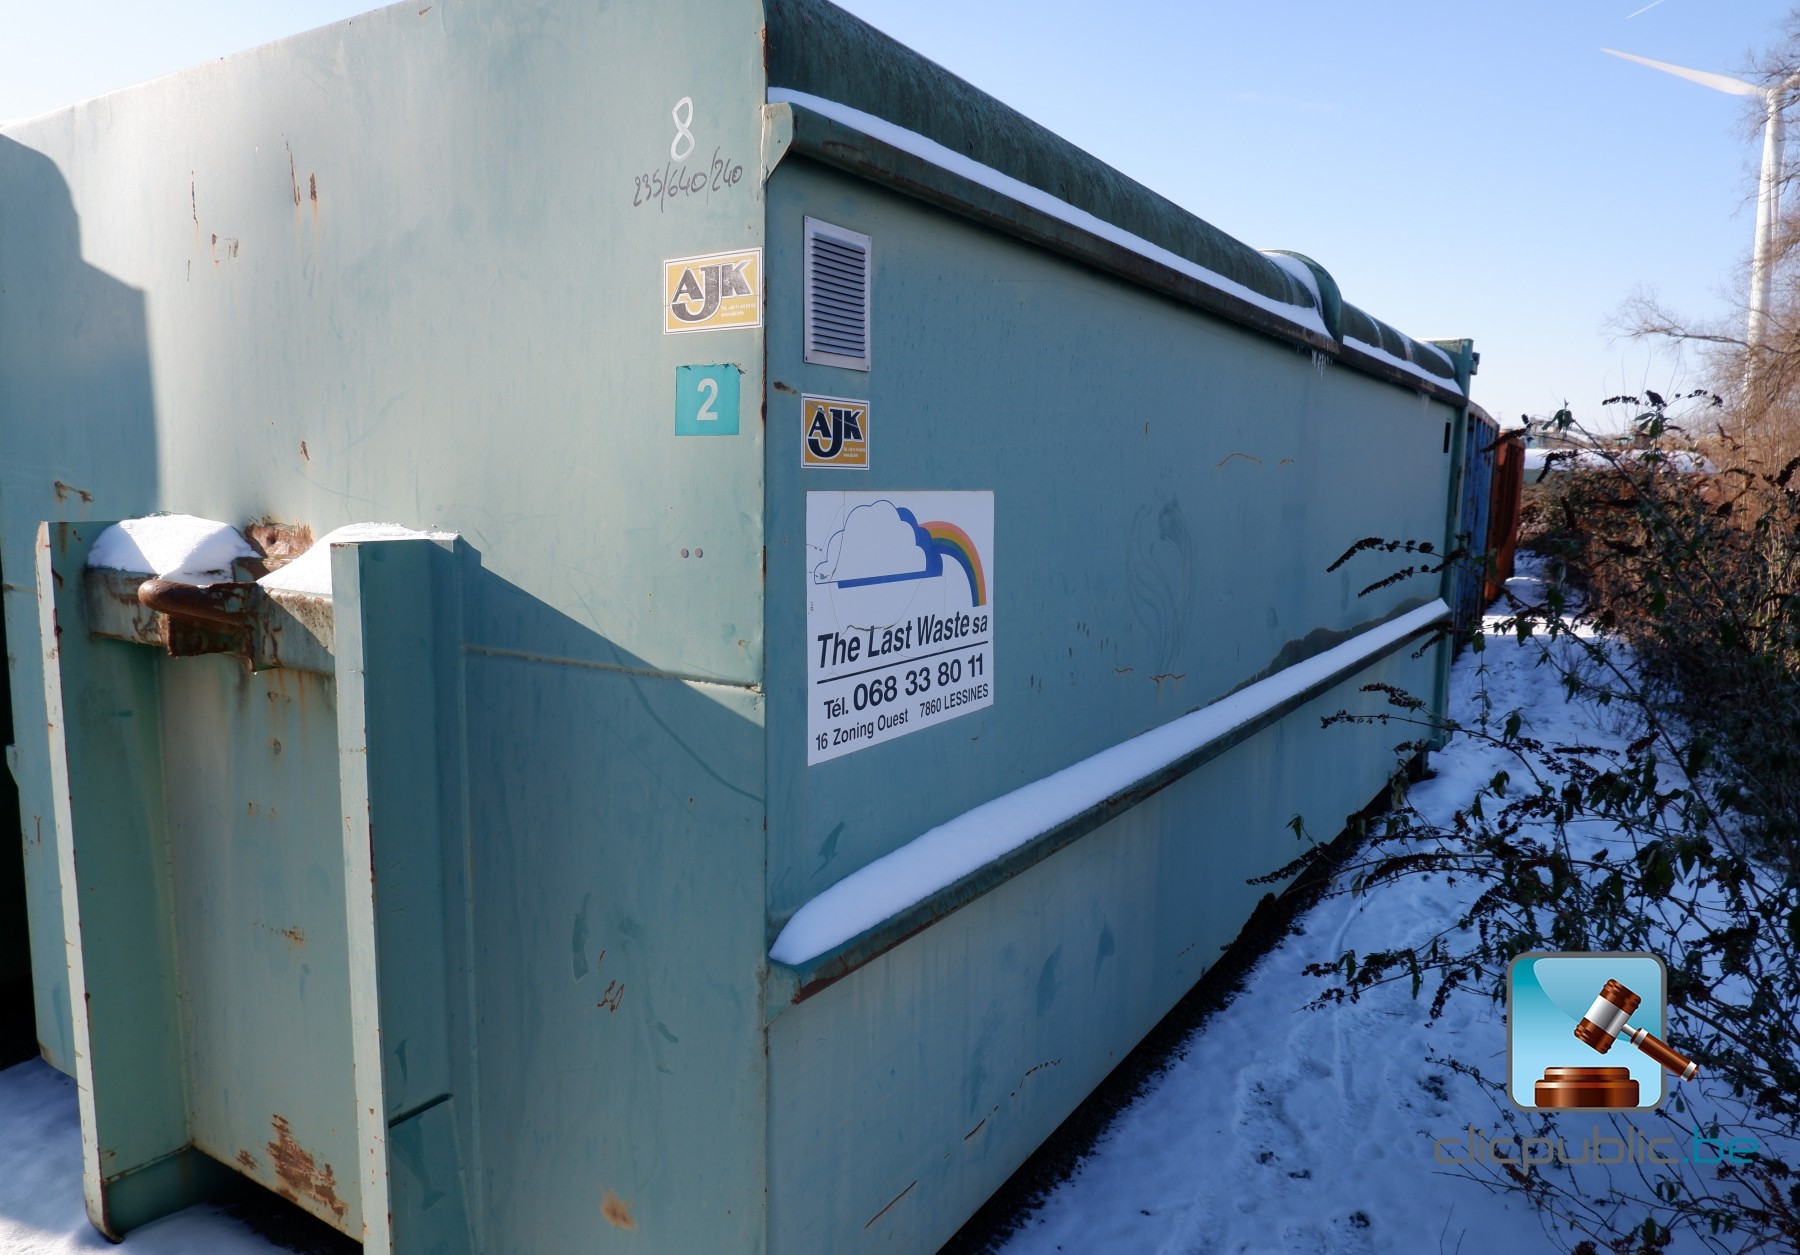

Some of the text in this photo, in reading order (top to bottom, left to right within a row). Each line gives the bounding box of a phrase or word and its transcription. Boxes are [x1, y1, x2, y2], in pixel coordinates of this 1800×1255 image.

[671, 96, 695, 163] 8
[670, 259, 753, 324] AJK
[696, 378, 719, 420] 2
[806, 405, 865, 460] AJK
[817, 611, 988, 668] The Last Waste sa
[815, 683, 989, 750] 16 Zoning Ouest 7860 LESSINES
[824, 653, 983, 719] Tél. 068 33 80 11
